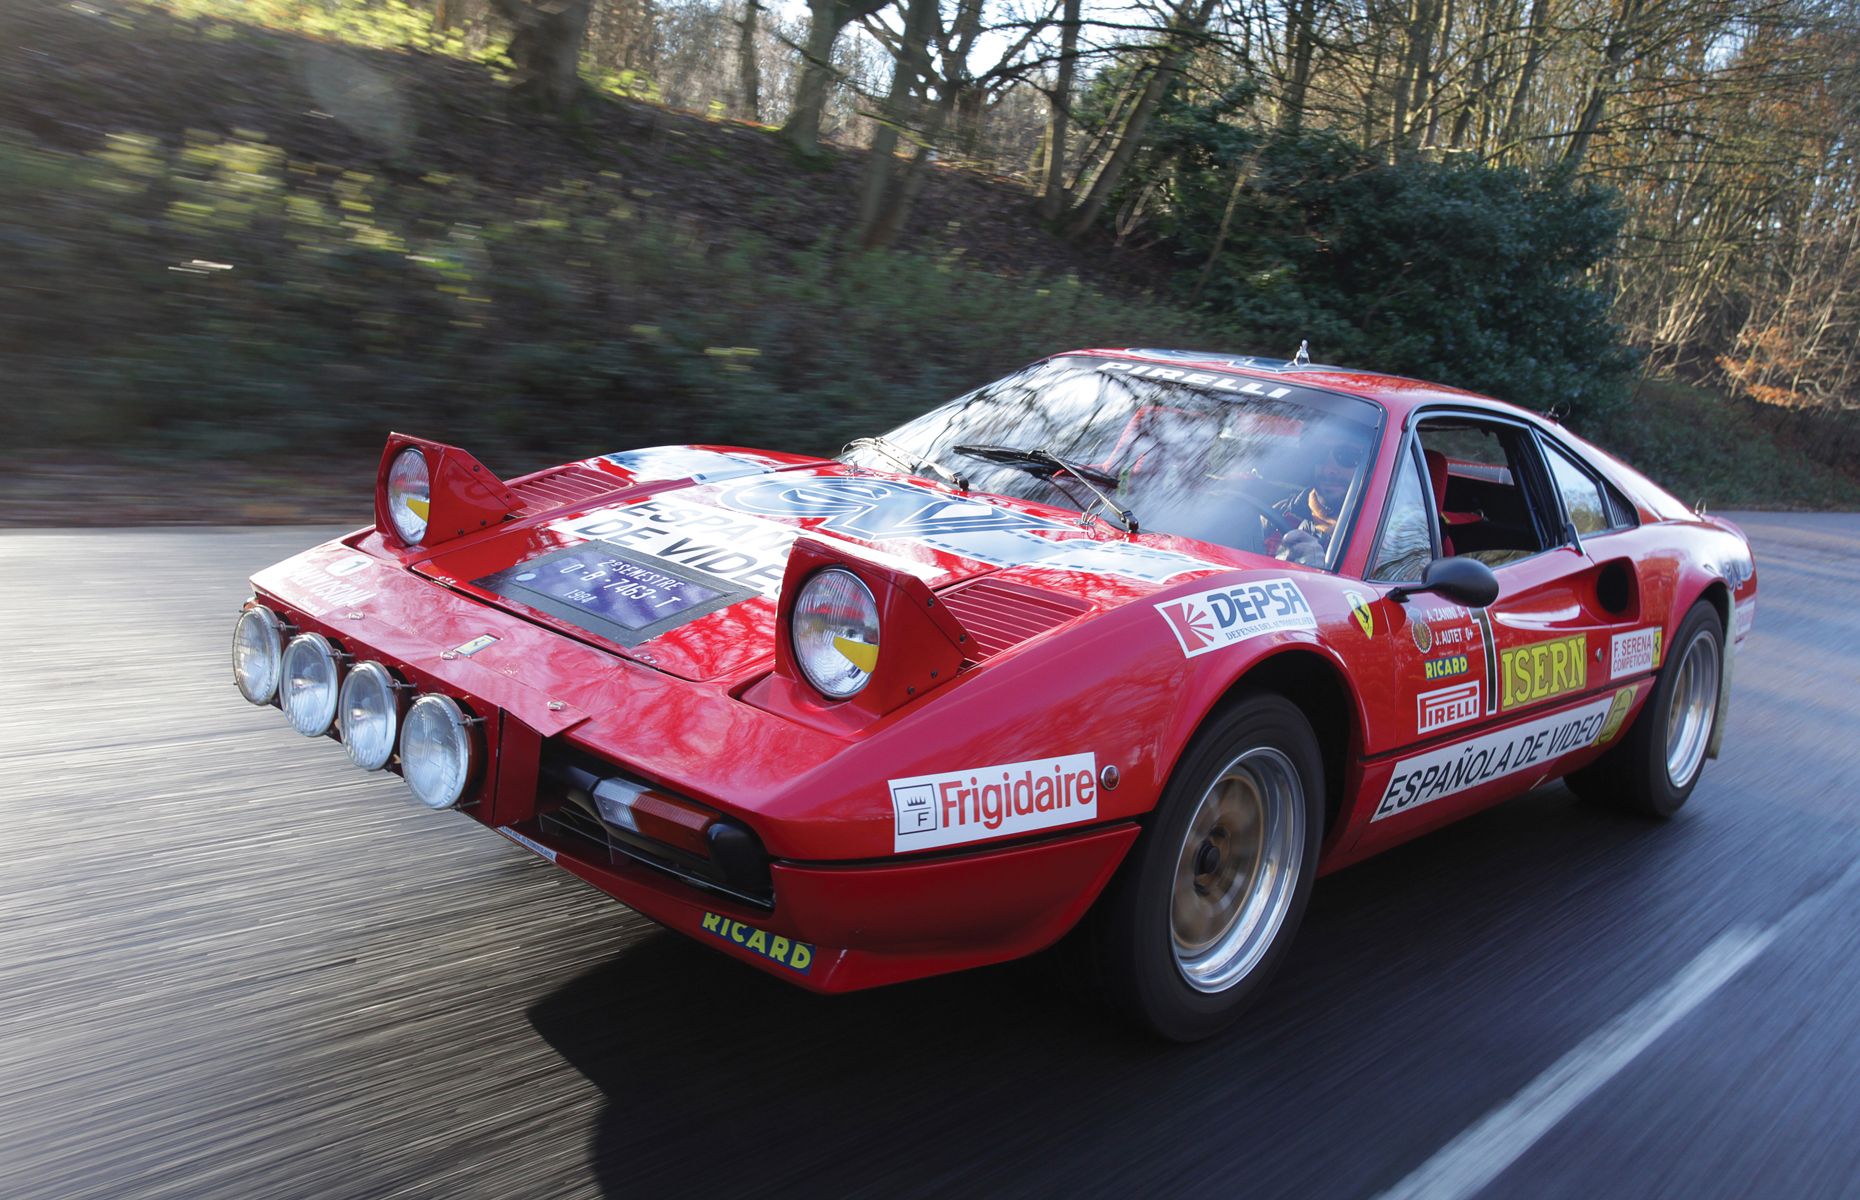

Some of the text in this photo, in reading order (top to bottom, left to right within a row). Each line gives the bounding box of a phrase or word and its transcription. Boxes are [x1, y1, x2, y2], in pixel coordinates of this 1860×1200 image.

[1096, 361, 1292, 399] PIRELLI
[574, 519, 788, 595] DE VIDE
[563, 589, 597, 603] 1984
[1206, 582, 1309, 629] DEPSA
[1425, 656, 1468, 679] RICARD
[1621, 635, 1652, 657] SERENA
[1501, 636, 1586, 708] ISERN
[1419, 685, 1479, 729] PIRELLI
[1378, 742, 1514, 814] ESPAÑOLA
[1511, 730, 1549, 769] DE
[1546, 711, 1605, 757] VIDEO
[938, 764, 1095, 831] Frigidaire
[702, 911, 811, 969] RICARD
